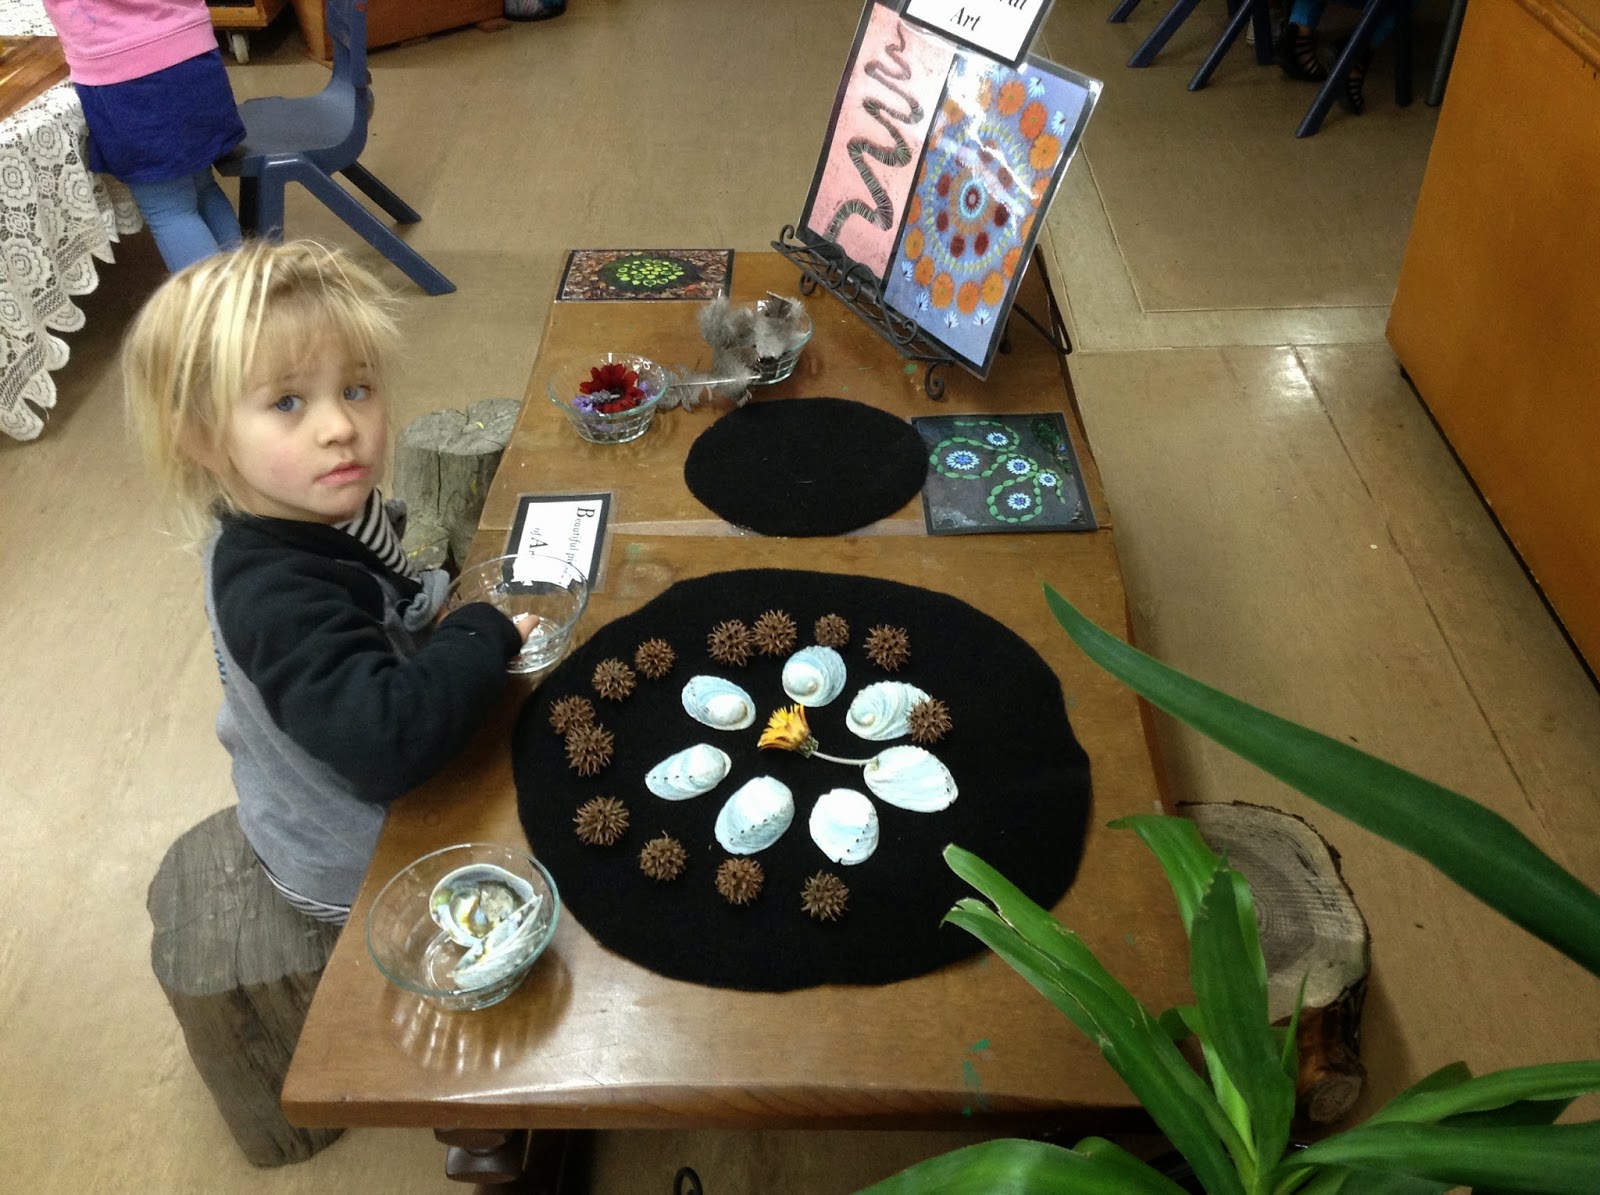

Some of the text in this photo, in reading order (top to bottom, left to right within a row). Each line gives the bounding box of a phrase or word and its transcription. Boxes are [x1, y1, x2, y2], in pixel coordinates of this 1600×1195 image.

[950, 7, 981, 31] Art
[528, 527, 549, 559] of Ar
[568, 507, 595, 551] Beautiful
